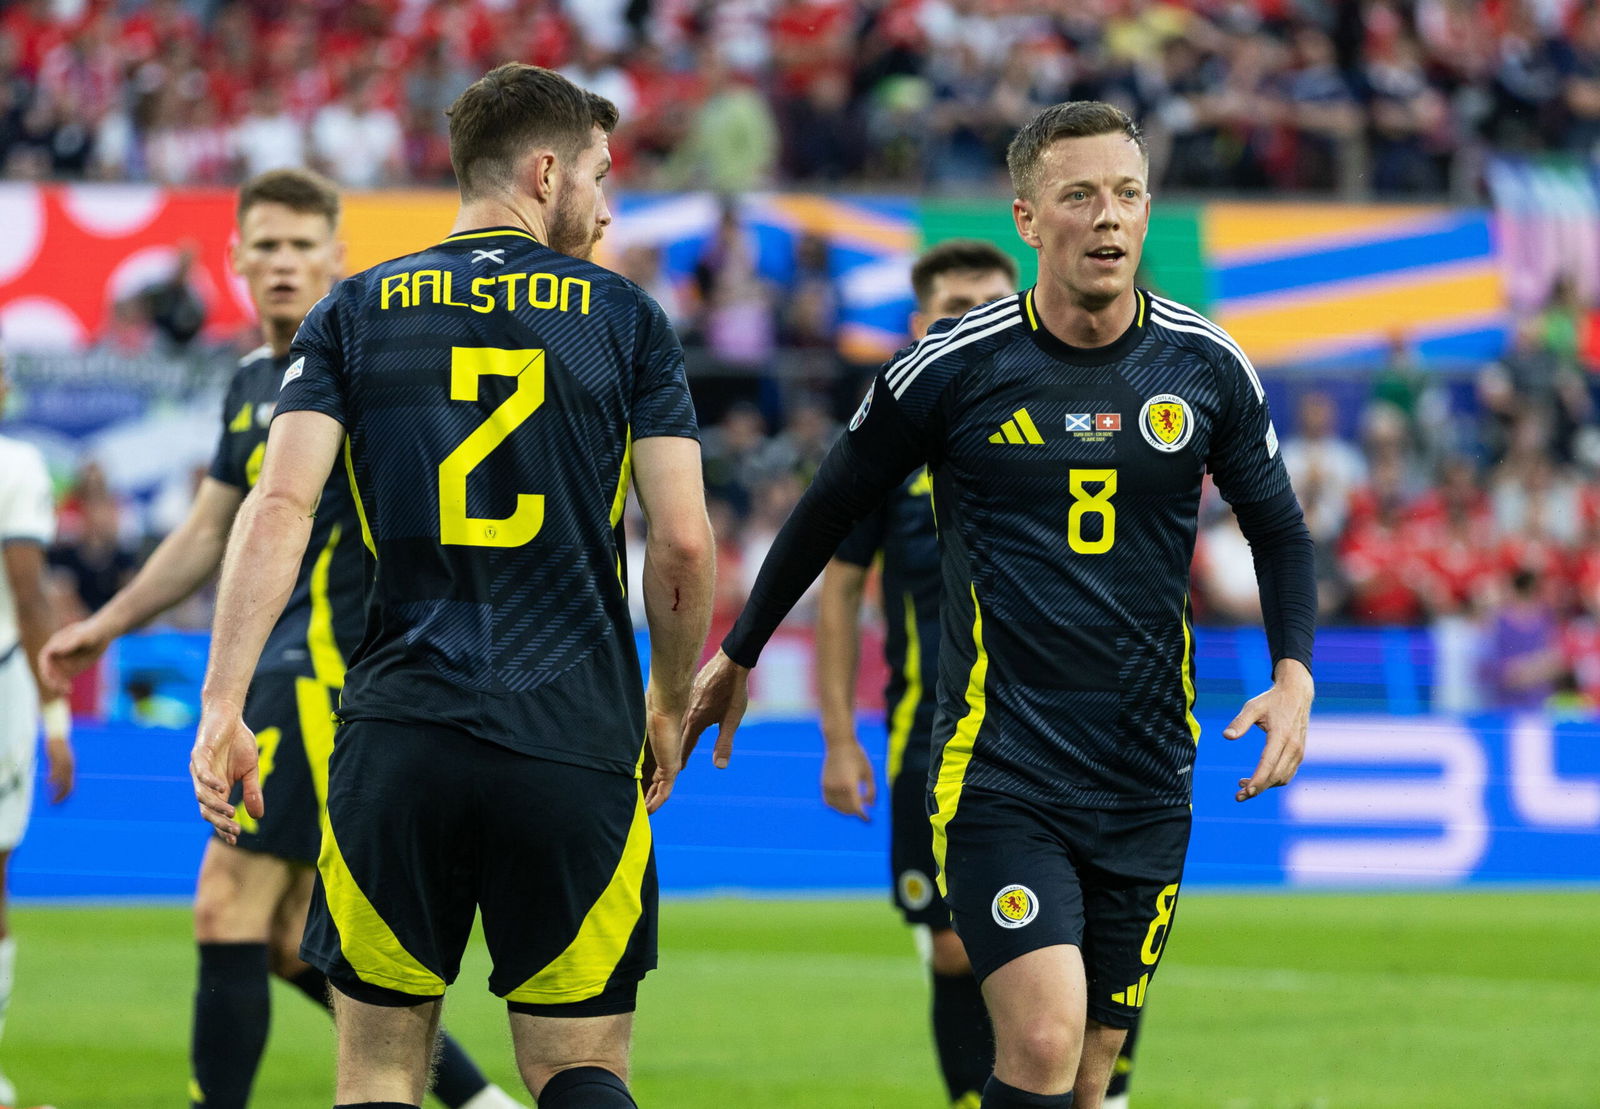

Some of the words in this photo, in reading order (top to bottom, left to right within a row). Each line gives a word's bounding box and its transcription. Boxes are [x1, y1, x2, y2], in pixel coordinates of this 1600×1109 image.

[381, 269, 591, 315] RALSTON
[439, 346, 545, 548] 2
[1067, 468, 1118, 555] 8
[1141, 883, 1179, 966] 8
